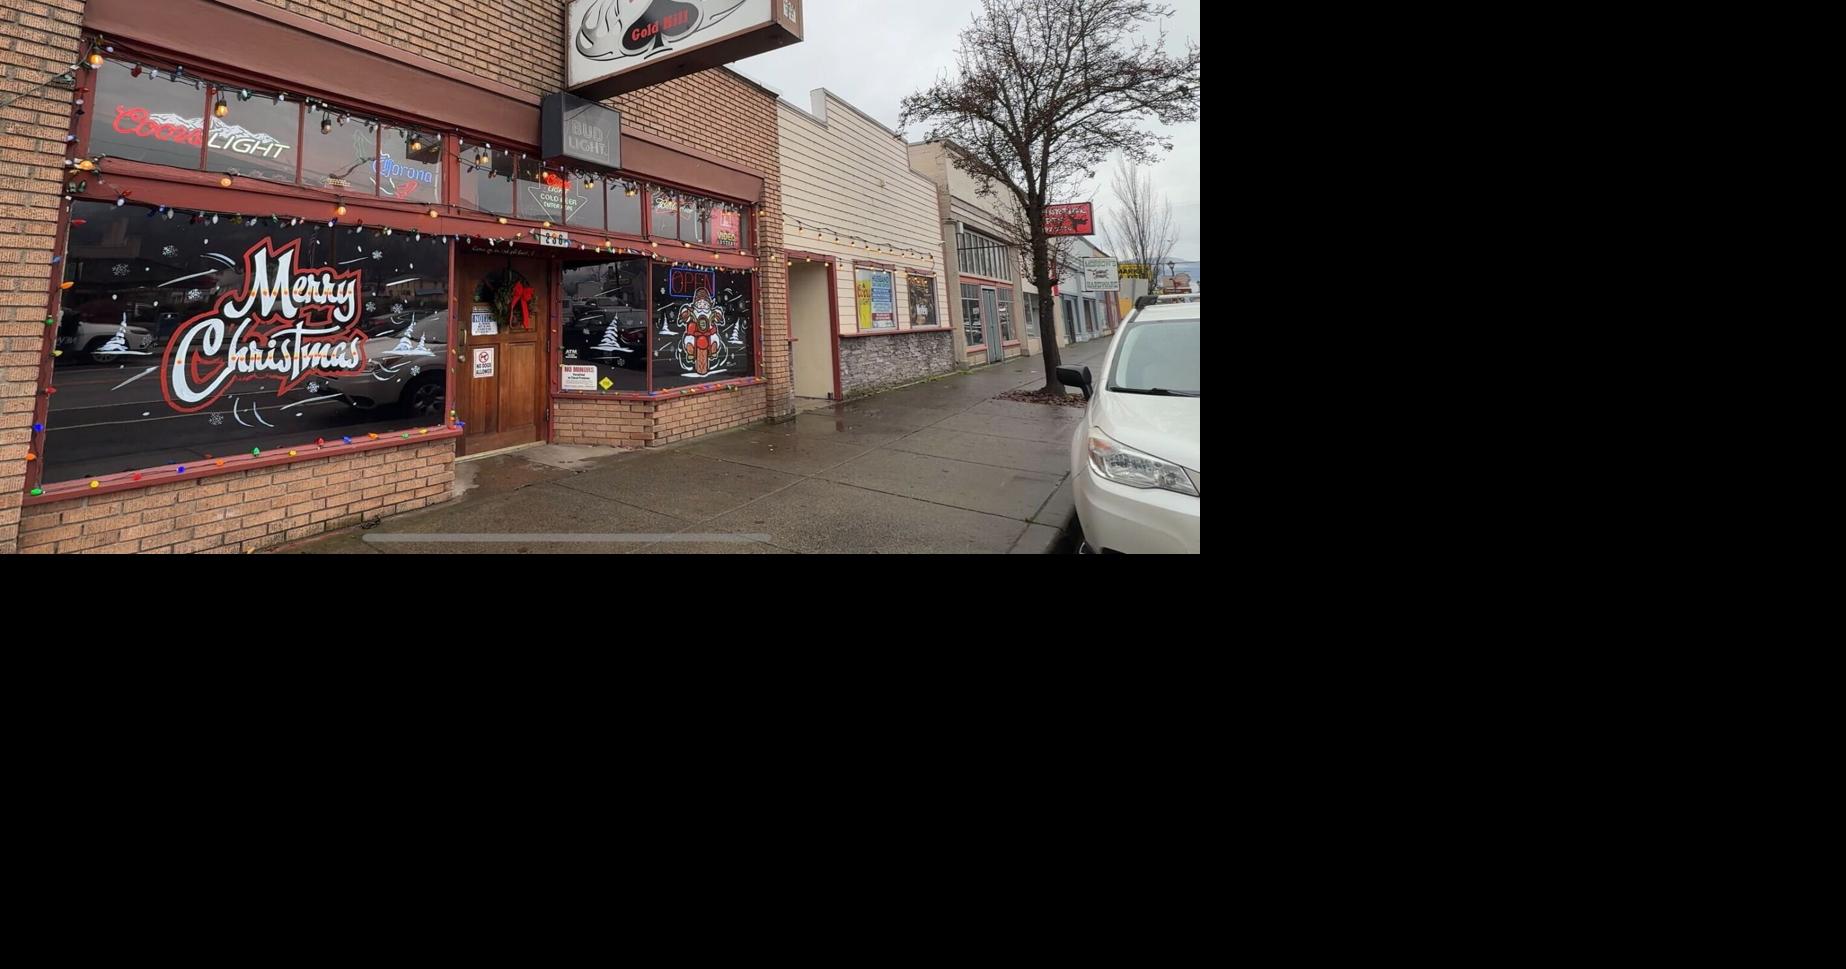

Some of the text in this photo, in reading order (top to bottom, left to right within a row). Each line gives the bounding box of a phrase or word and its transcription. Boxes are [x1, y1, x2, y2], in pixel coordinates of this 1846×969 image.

[631, 9, 690, 41] Gold Hill
[112, 105, 290, 158] Coors LIGHT
[571, 119, 604, 142] BUD
[568, 135, 605, 155] LIGHT
[372, 159, 432, 183] Corona
[541, 193, 577, 206] COLD BER
[223, 247, 357, 323] Merry
[672, 271, 714, 294] OPEN
[172, 317, 360, 403] Christmas
